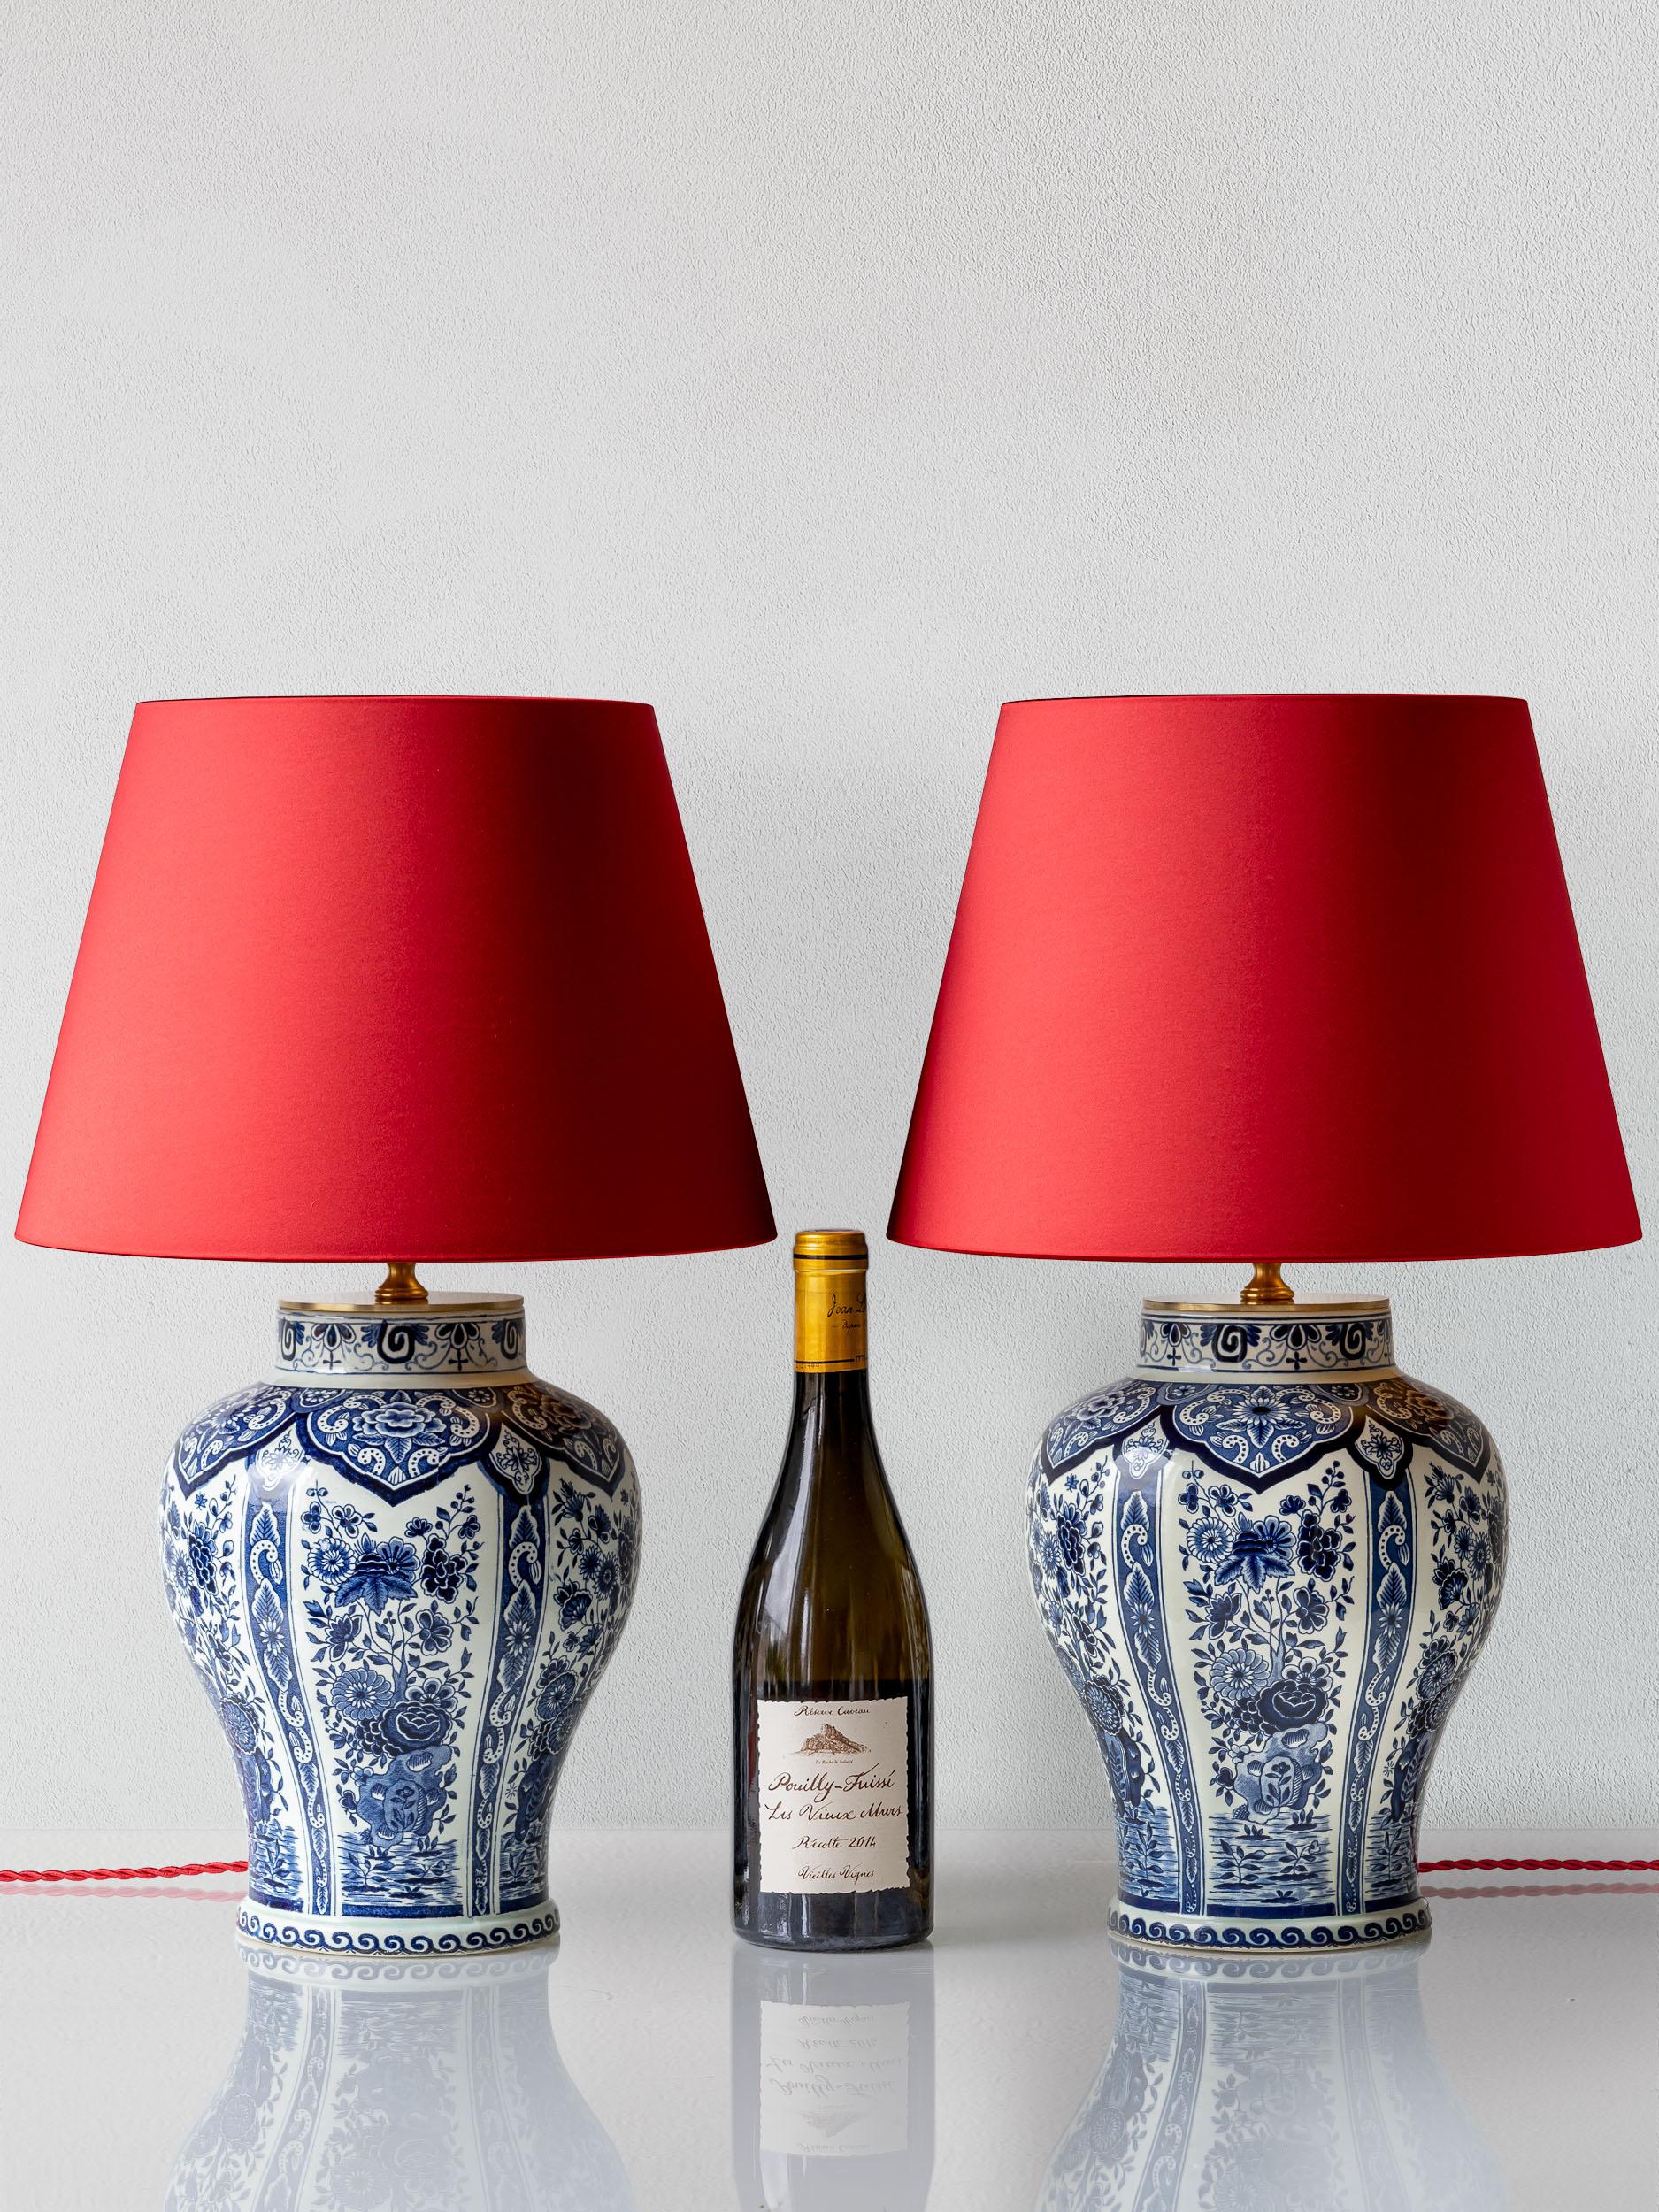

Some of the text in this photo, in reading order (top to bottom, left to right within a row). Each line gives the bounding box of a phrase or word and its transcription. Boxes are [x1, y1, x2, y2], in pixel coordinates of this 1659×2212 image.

[827, 1294, 853, 1317] Jean
[837, 1705, 872, 1716] Caveau
[768, 1763, 895, 1803] Pouilly-Fuissé
[764, 1801, 903, 1821] Les Vieux Murs
[792, 1836, 877, 1850] Récolte 2014
[798, 1863, 875, 1885] Vieilles Vignes
